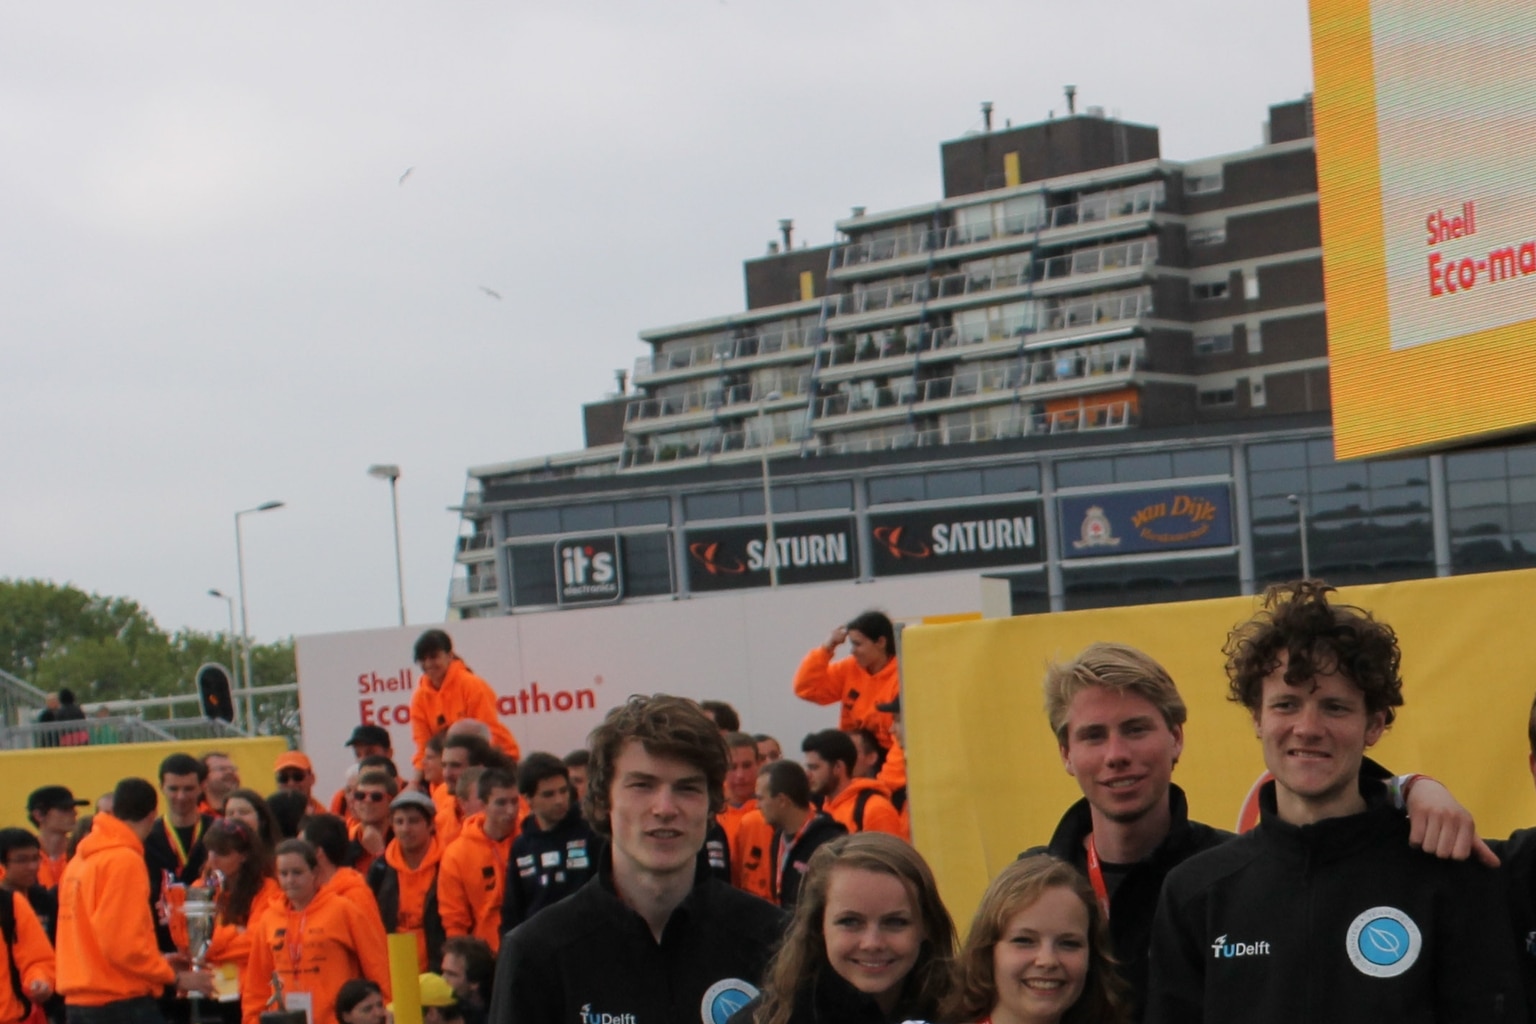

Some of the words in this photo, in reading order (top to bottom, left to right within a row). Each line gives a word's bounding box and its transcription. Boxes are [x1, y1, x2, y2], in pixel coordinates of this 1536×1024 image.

[1426, 201, 1476, 245] Shell
[746, 532, 847, 570] SATURN
[931, 516, 1035, 555] SATURN
[358, 669, 412, 694] Shell
[359, 682, 596, 727] Ecoathon
